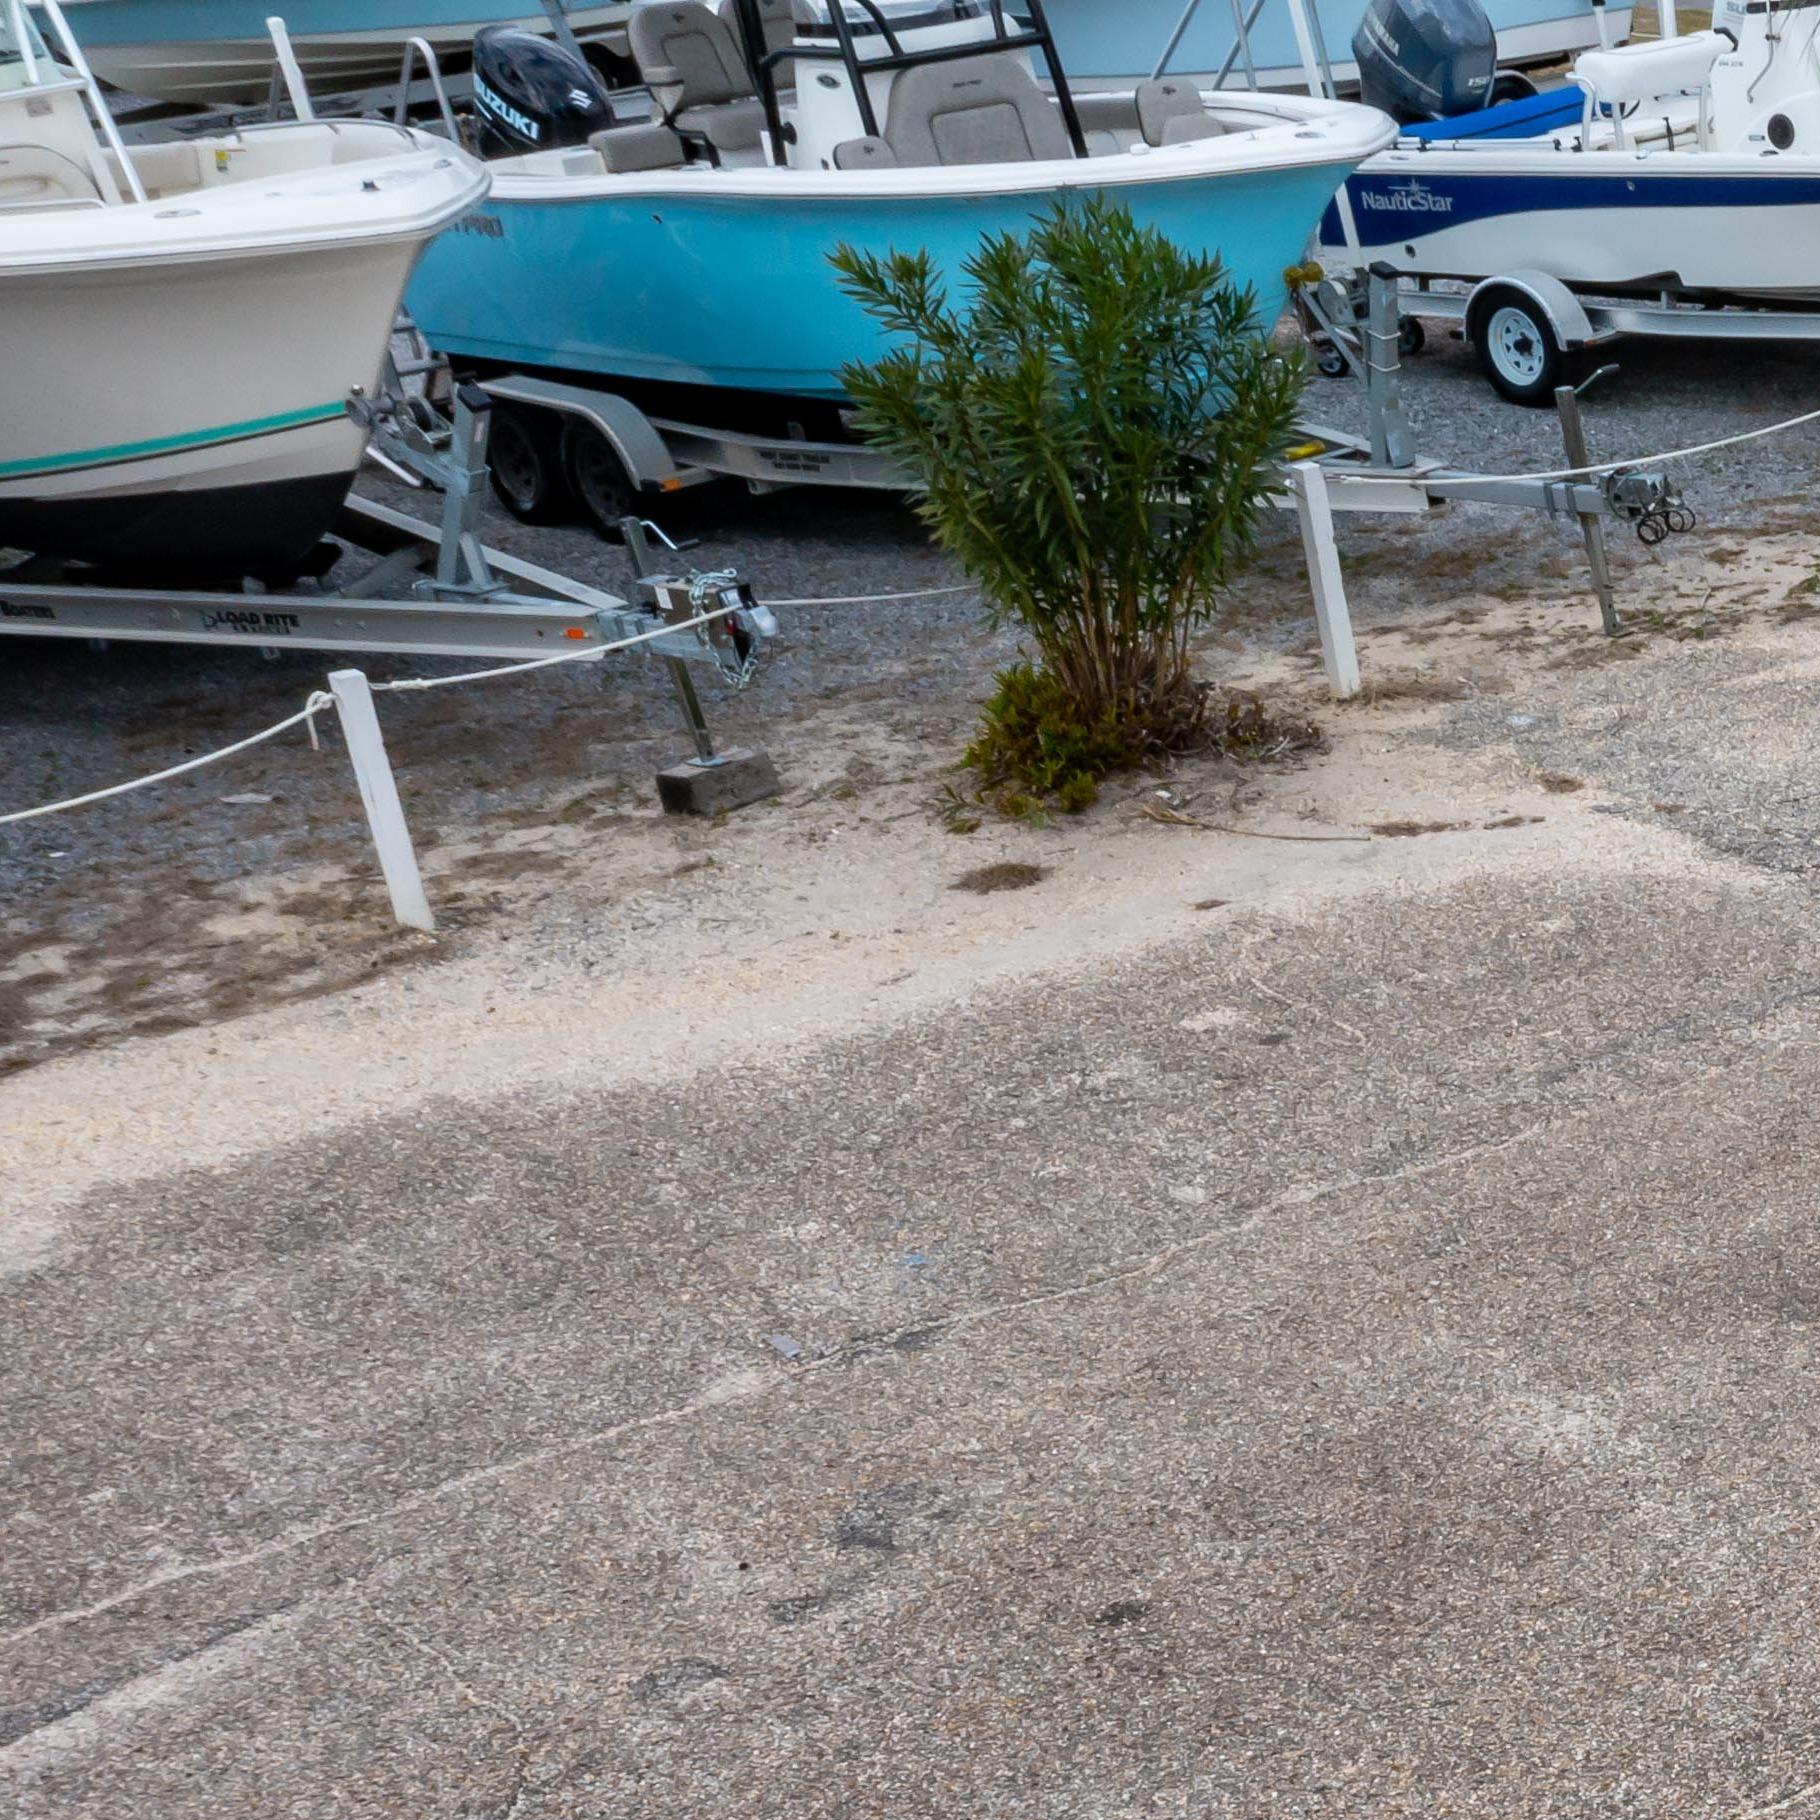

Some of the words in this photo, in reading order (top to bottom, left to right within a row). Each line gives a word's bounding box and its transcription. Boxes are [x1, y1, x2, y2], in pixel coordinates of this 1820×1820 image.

[473, 73, 540, 140] SUZUKI
[1361, 187, 1453, 212] NauticStar
[216, 610, 260, 625] LOAD
[264, 613, 300, 628] RITE
